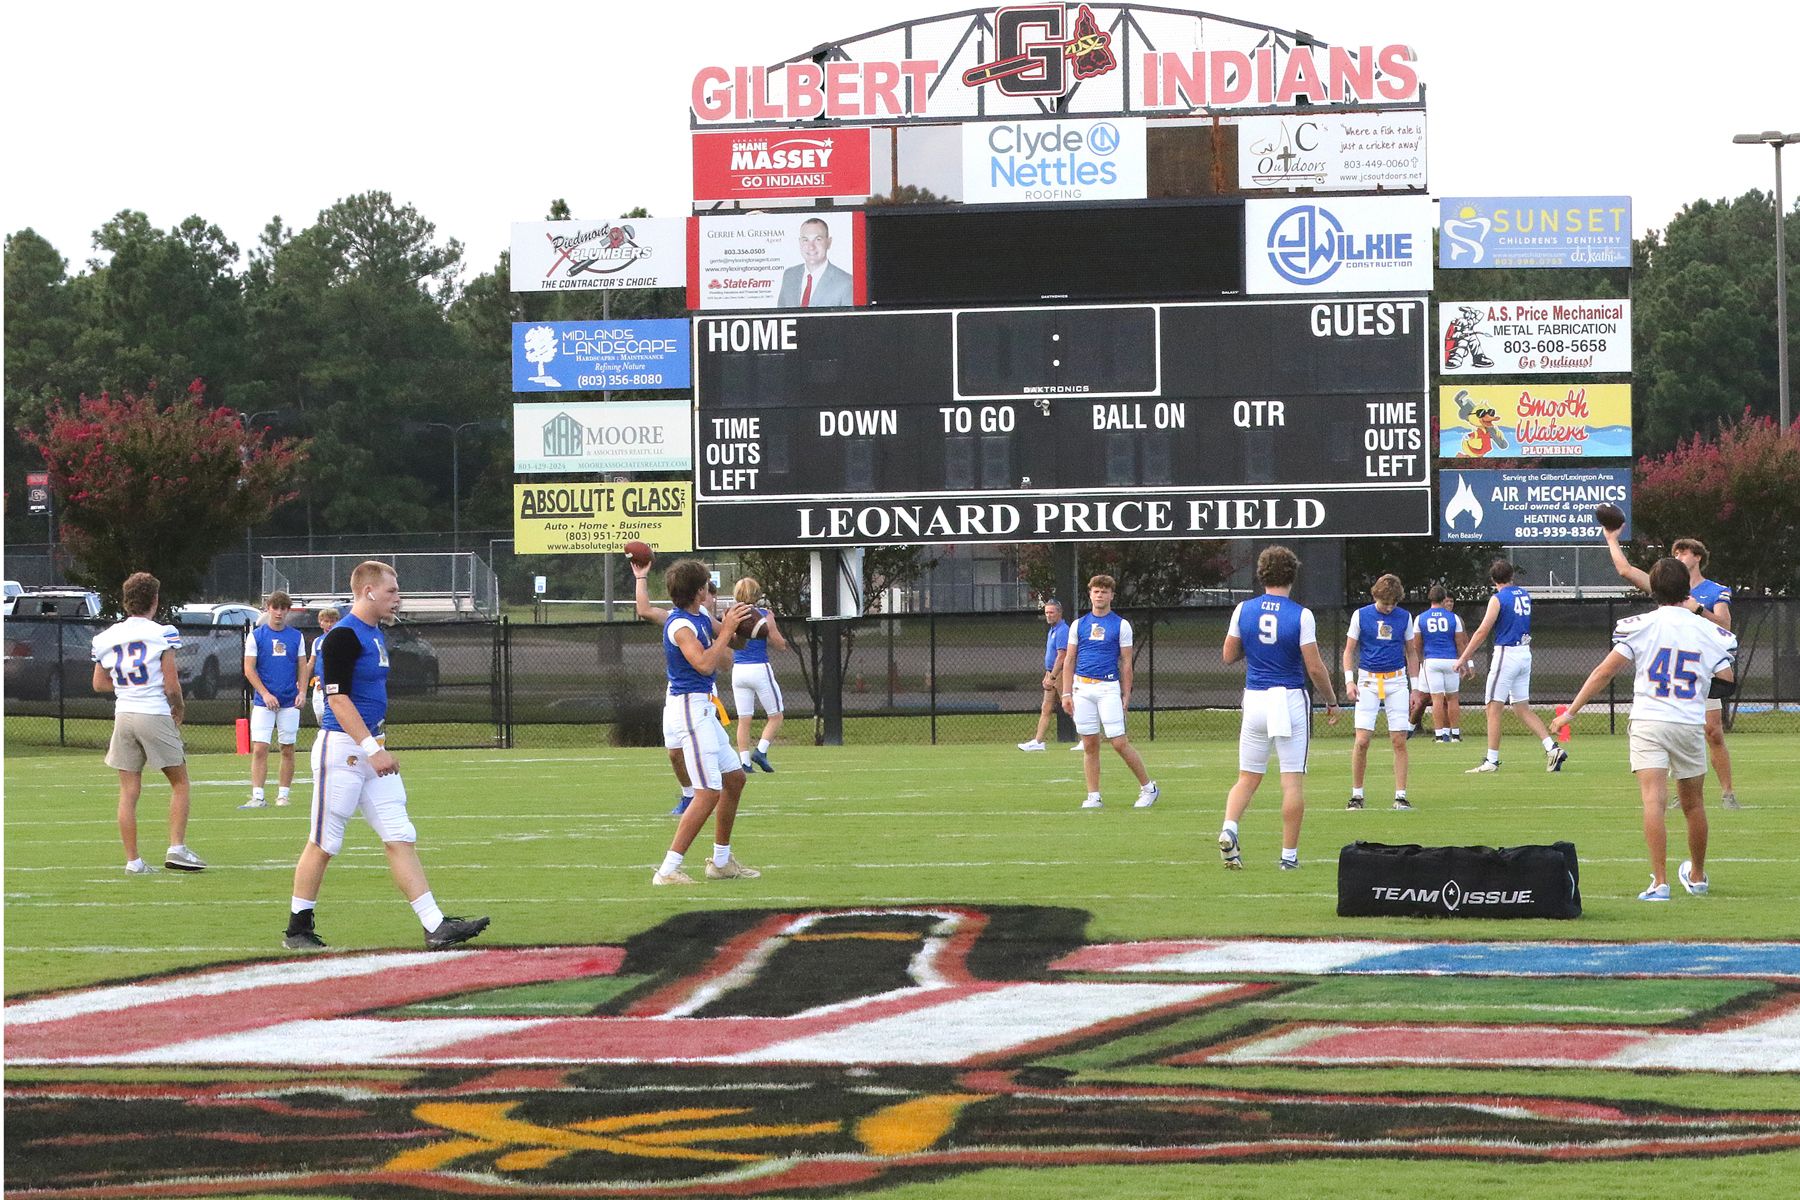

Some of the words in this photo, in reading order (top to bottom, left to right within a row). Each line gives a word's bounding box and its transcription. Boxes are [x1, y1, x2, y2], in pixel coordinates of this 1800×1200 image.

[1143, 44, 1418, 107] INDIANS
[692, 60, 938, 121] GILBERT
[1397, 125, 1413, 135] tale
[1416, 125, 1422, 134] is
[732, 142, 768, 152] SHANE
[988, 124, 1083, 160] Clyde
[1340, 142, 1356, 153] just
[1366, 141, 1396, 150] cricket
[730, 149, 833, 171] MASSEY
[1344, 159, 1409, 169] 803-449-0060
[991, 153, 1117, 188] Nettles
[1340, 172, 1422, 182] www.jcsoutdoors.net
[742, 176, 762, 187] GO
[766, 174, 825, 186] INDIANS!
[1025, 189, 1082, 200] ROOFING
[1493, 208, 1626, 233] SUNSET
[552, 223, 610, 252] Piedmont
[1498, 237, 1558, 245] CHILDREN'S
[1566, 236, 1621, 244] DENTISTRY
[569, 247, 652, 261] PLUMBERS
[1346, 260, 1412, 269] CONSTRUCTION
[541, 280, 557, 289] THE
[559, 278, 624, 288] CONTRACTOR'S
[626, 277, 658, 287] CHOICE
[1311, 302, 1415, 337] GUEST
[1487, 306, 1512, 322] A.S.
[1516, 306, 1548, 321] Price
[1553, 304, 1623, 321] Mechanical
[562, 329, 633, 341] MIDLANDS
[708, 319, 798, 352] HOME
[1493, 324, 1533, 336] METAL
[1537, 323, 1616, 335] FABRICATION
[562, 339, 677, 355] LANDSCAPE
[1504, 339, 1607, 354] 803-608-5658
[595, 362, 621, 372] Refining
[622, 362, 646, 370] Nature
[1518, 355, 1536, 369] Go
[1540, 355, 1593, 369] Indians!
[578, 375, 606, 388] (803)
[609, 374, 662, 385] 356-8080
[1023, 385, 1089, 393] DAKTRONICS
[1516, 388, 1589, 418] Smooth
[940, 407, 972, 433] TO
[980, 406, 1015, 432] GO
[1092, 403, 1147, 430] BALL
[1154, 402, 1184, 429] ON
[1233, 400, 1285, 429] QTR
[1366, 402, 1417, 425] TIME
[712, 418, 760, 440] TIME
[819, 410, 897, 437] DOWN
[1516, 417, 1589, 443] Waters
[586, 426, 664, 445] MOORE
[1365, 428, 1421, 451] OUTS
[706, 442, 761, 465] OUTS
[1522, 446, 1582, 455] PLUMBING
[1366, 454, 1417, 477] LEFT
[710, 469, 759, 491] LEFT
[1502, 474, 1526, 483] Serving
[1540, 474, 1597, 482] Gilbert/Lexington
[622, 487, 682, 517] GLASS
[1491, 487, 1519, 502] AIR
[1528, 485, 1627, 502] MECHANICS
[521, 488, 616, 519] ABSOLUTE
[1503, 502, 1528, 511] Local
[1530, 502, 1560, 510] owned
[544, 522, 568, 530] Auto
[579, 521, 608, 530] Home
[619, 521, 662, 529] Business
[797, 504, 1021, 540] LEONARD
[1033, 500, 1174, 536] PRICE
[1186, 498, 1326, 531] FIELD
[1524, 514, 1567, 523] HEATING
[1577, 514, 1593, 523] AIR
[565, 531, 591, 542] (803)
[593, 531, 640, 540] 951-7200
[1460, 532, 1483, 540] Beasley
[1515, 527, 1603, 537] 803-939-8367
[1261, 602, 1280, 612] CATS
[1514, 596, 1531, 616] 45
[1258, 613, 1278, 645] 9
[1427, 618, 1448, 633] 60
[111, 640, 149, 686] 13
[1648, 647, 1701, 700] 45
[1371, 887, 1440, 903] TEAM
[1462, 890, 1534, 904] ISSUE
